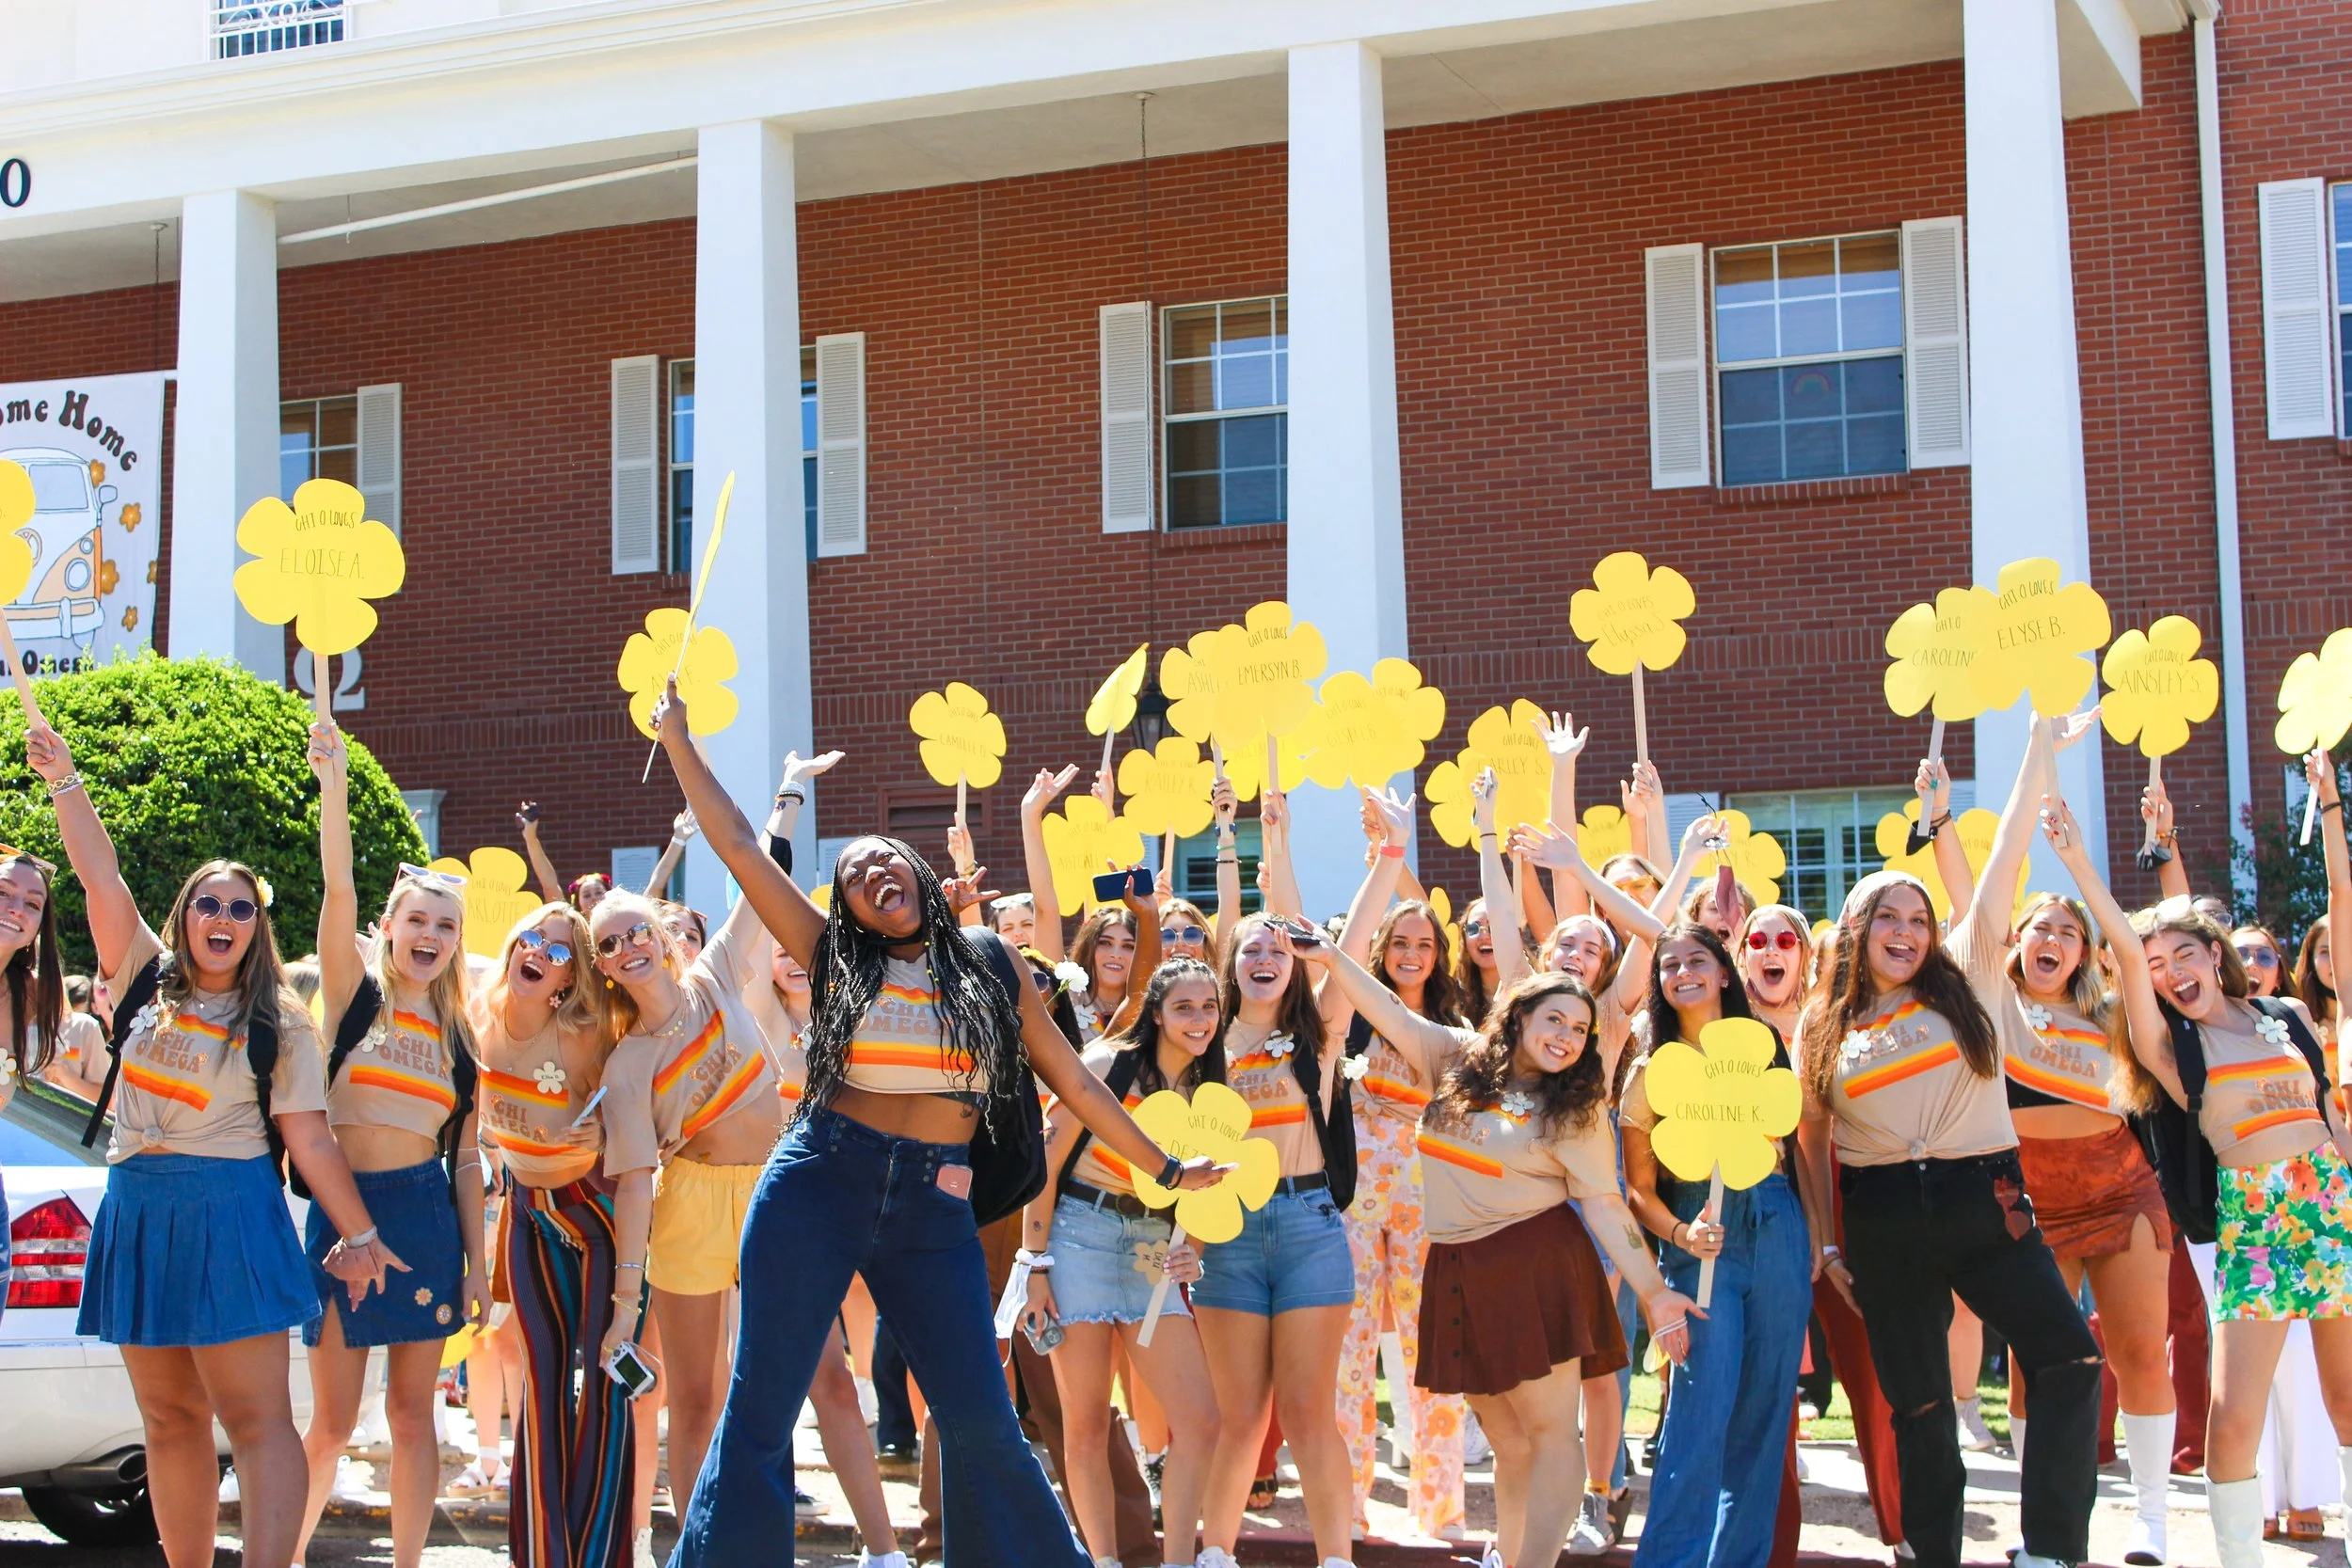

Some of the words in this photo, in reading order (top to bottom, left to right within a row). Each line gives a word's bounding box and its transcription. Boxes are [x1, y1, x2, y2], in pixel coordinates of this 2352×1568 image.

[58, 389, 137, 471] Home
[319, 510, 326, 526] O
[329, 509, 357, 529] LOVES
[280, 547, 345, 577] ELOISE
[348, 552, 365, 579] A.
[1999, 588, 2019, 610] CHI
[2019, 583, 2027, 599] O
[2028, 579, 2055, 596] LOVES
[1263, 629, 1269, 639] O
[1270, 626, 1288, 640] LOVES
[1996, 619, 2047, 651] ELYSE
[2048, 615, 2066, 638] B.
[1237, 659, 1290, 686] EMERSYN
[1292, 658, 1303, 680] B.
[2118, 668, 2189, 695] AINSLEY
[468, 896, 520, 927] ARLOTTE
[882, 1000, 928, 1018] CHI
[135, 1038, 202, 1073] OMEGA
[398, 1036, 433, 1060] CHI
[379, 1044, 450, 1082] OMEGA
[1368, 1055, 1409, 1081] OMEG
[1704, 1059, 1724, 1080] CHI
[1727, 1059, 1734, 1072] O
[1736, 1059, 1763, 1079] LOVES
[2029, 1046, 2097, 1078] OMEGA
[1248, 1080, 1289, 1101] EGA
[493, 1100, 527, 1124] CHI
[1676, 1102, 1745, 1123] CAROLINE
[1752, 1105, 1765, 1122] K.
[1210, 1117, 1217, 1131] O
[1219, 1121, 1241, 1143] LOVES
